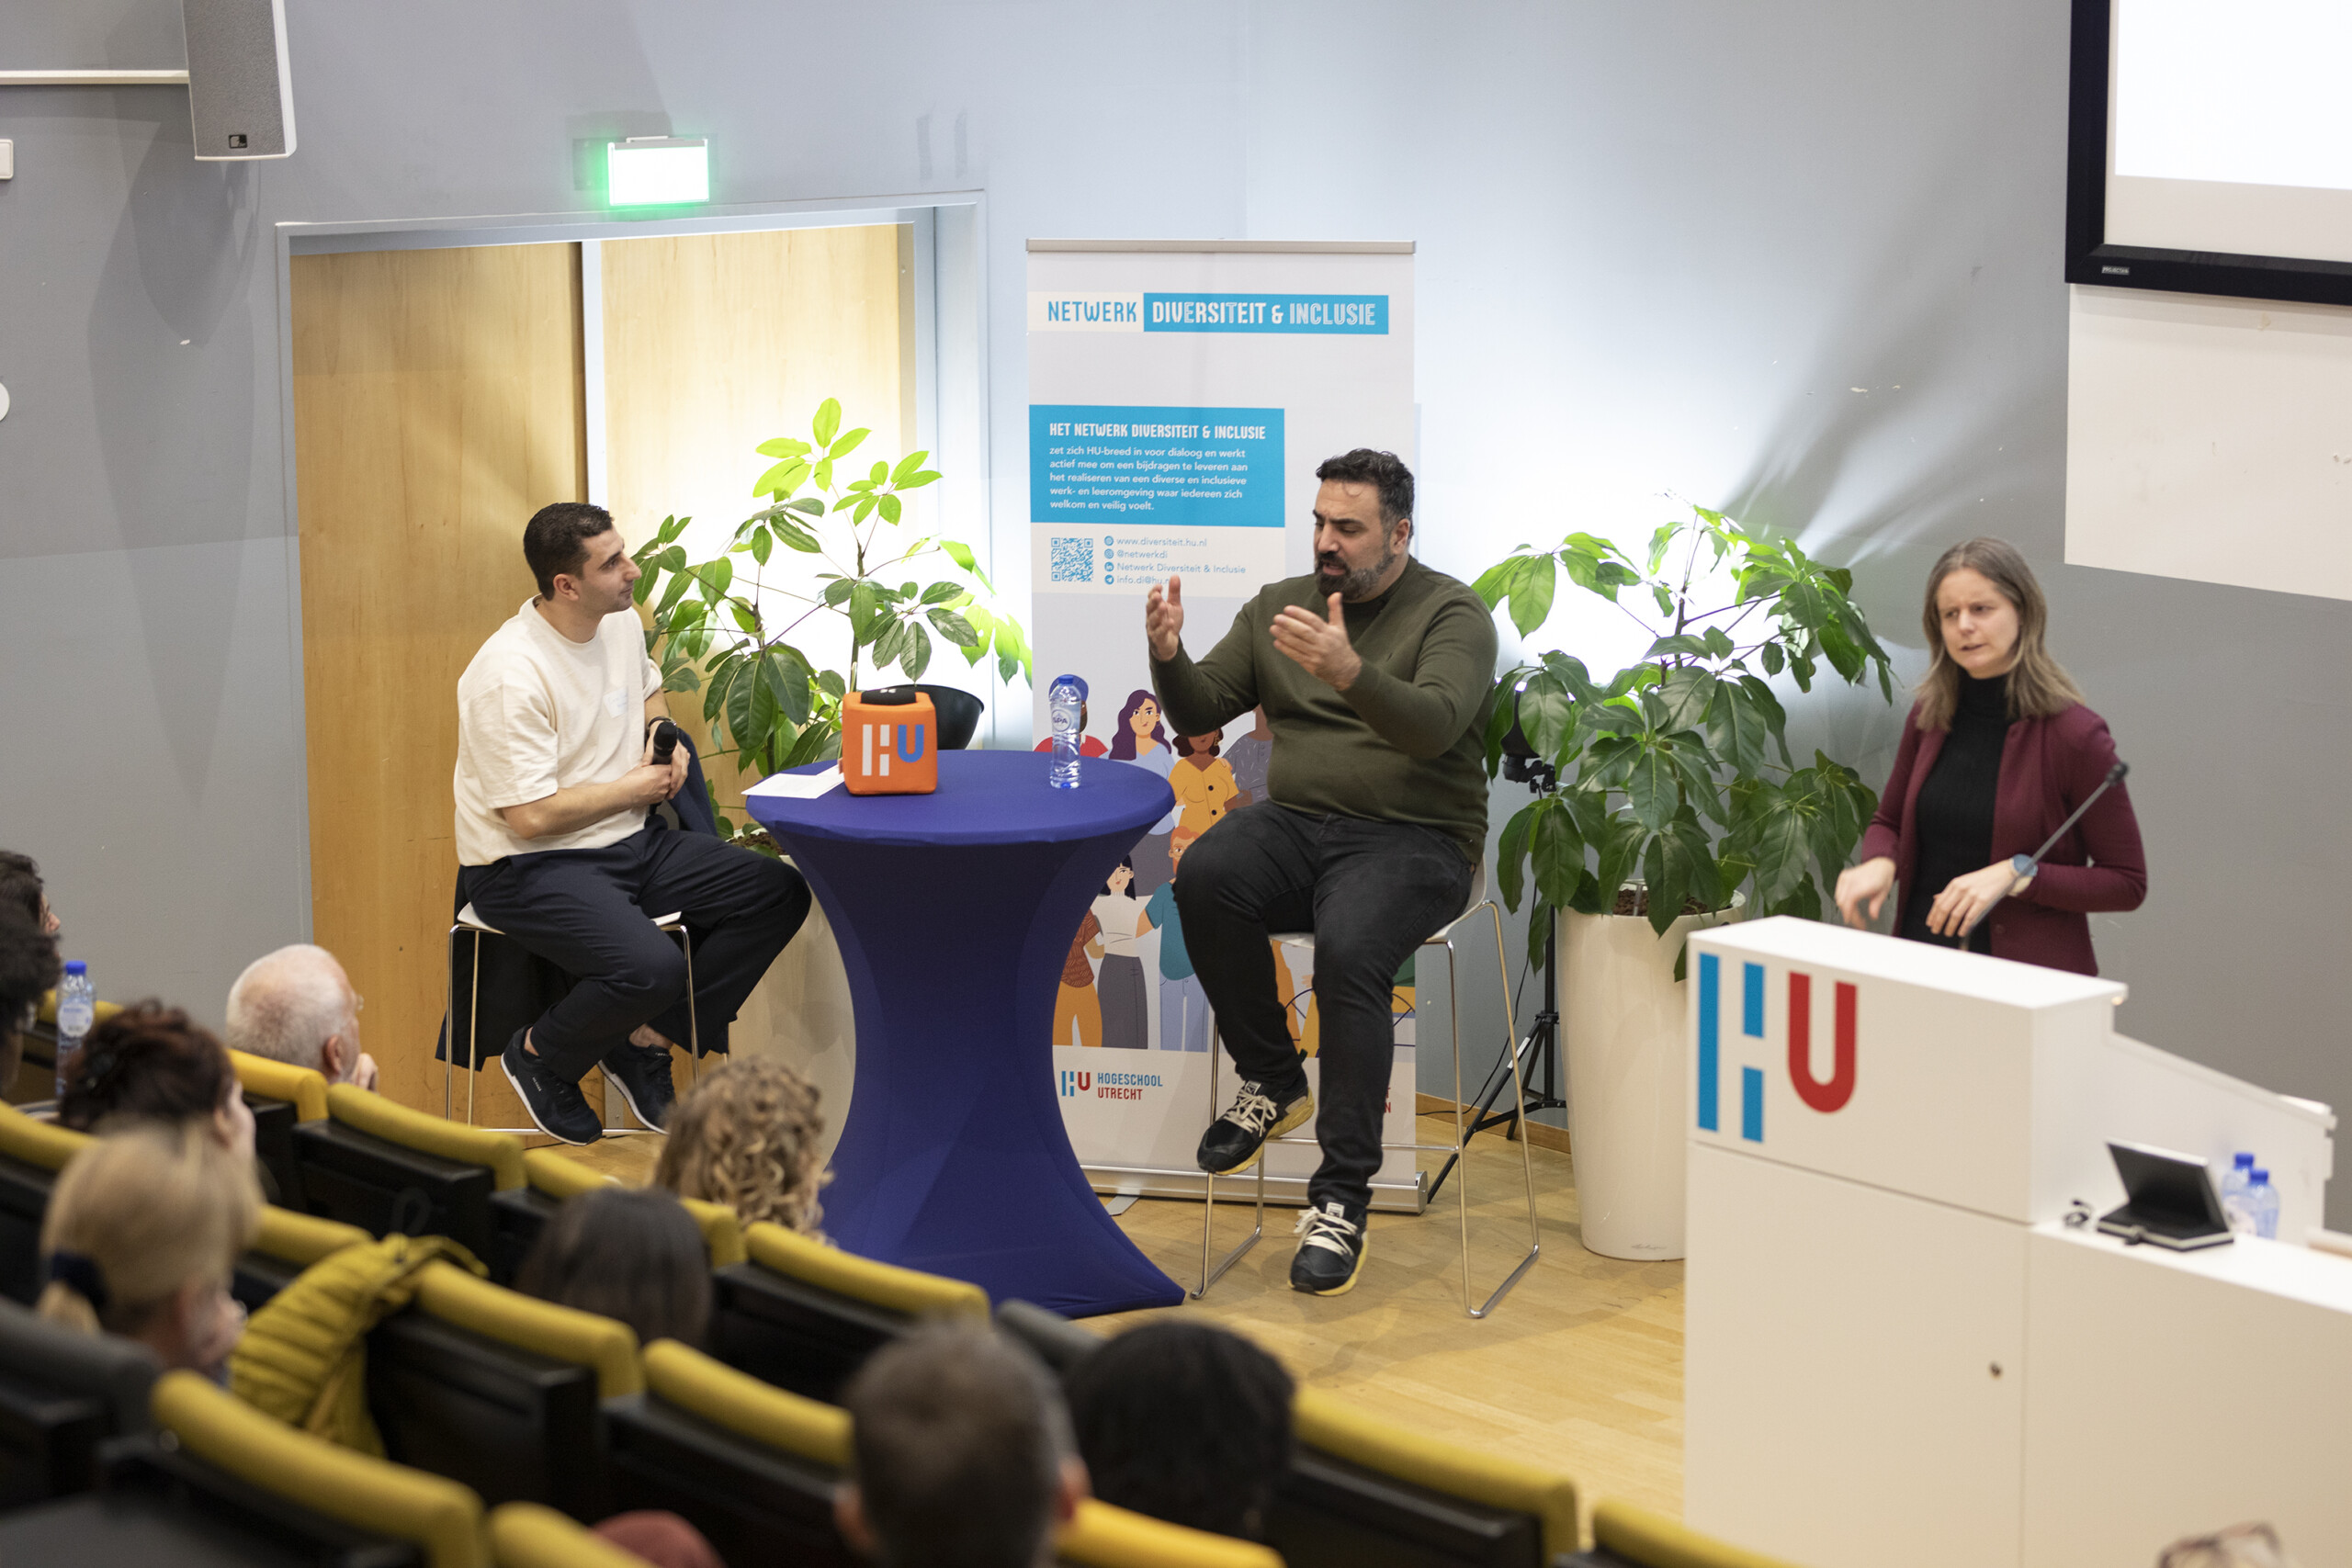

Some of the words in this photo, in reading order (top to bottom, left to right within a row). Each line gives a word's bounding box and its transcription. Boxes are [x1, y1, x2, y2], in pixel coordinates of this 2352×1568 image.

[1047, 299, 1136, 322] NETWERK
[1151, 300, 1267, 324] DIVERSITEIT
[1271, 304, 1284, 324] &
[1289, 302, 1376, 326] INCLUSIE
[1049, 423, 1071, 436] HET
[1074, 423, 1128, 437] NETWERK
[1131, 423, 1200, 439] DIVERSITEIT
[1202, 424, 1212, 439] &
[1214, 424, 1266, 440] INCLUSIE
[1049, 446, 1064, 455] zet
[1066, 446, 1085, 455] zich
[1086, 446, 1132, 457] HU-breed
[1133, 447, 1143, 456] in
[1144, 448, 1166, 457] voor
[1169, 447, 1204, 459] dialoog
[1218, 447, 1246, 458] werkt
[1049, 458, 1076, 468] actief
[1136, 460, 1181, 473] bijdragen
[1182, 462, 1193, 471] te
[1194, 461, 1229, 471] leveren
[1049, 471, 1066, 482] het
[1067, 472, 1112, 482] realiseren
[1151, 474, 1186, 484] diverse
[1201, 475, 1248, 485] inclusieve
[1049, 485, 1076, 495] werk-
[1091, 486, 1155, 500] leeromgeving
[1156, 490, 1180, 498] waar
[1181, 488, 1223, 499] iedereen
[1224, 489, 1243, 499] zich
[1049, 499, 1086, 509] welkom
[1102, 500, 1126, 513] veilig
[1128, 501, 1155, 511] voelt.
[1116, 536, 1207, 547] www.diversiteit.hu.nl
[1116, 549, 1168, 559] @netwerkdi
[1116, 562, 1154, 572] Netwerk
[1157, 563, 1201, 573] Diversiteit
[1204, 564, 1211, 573] &
[1213, 564, 1246, 574] Inclusie
[1116, 574, 1170, 585] info.di@hu.n
[862, 724, 924, 776] HU
[1698, 952, 1858, 1143] HU
[1061, 1070, 1091, 1097] HU
[1097, 1072, 1163, 1087] HOGESCHOOL
[1097, 1088, 1143, 1100] UTRECHT
